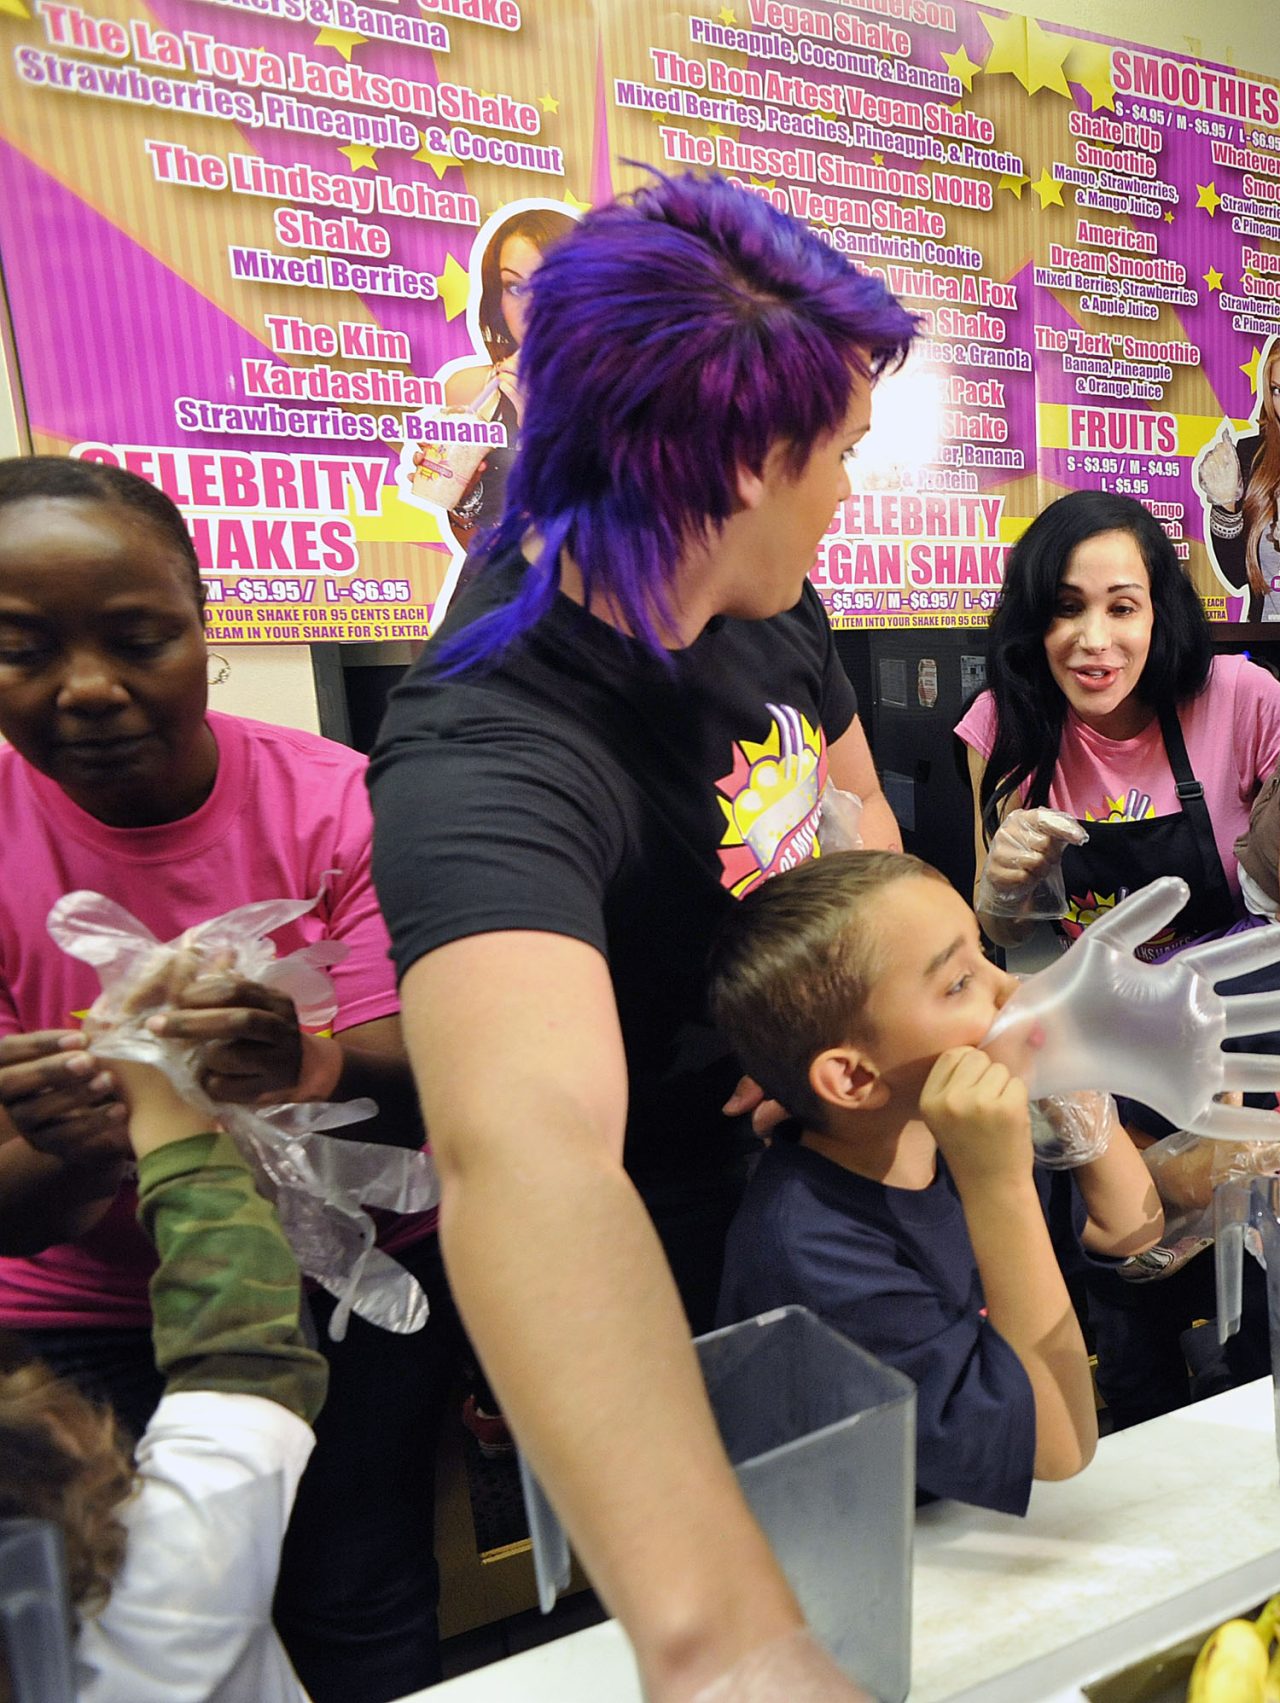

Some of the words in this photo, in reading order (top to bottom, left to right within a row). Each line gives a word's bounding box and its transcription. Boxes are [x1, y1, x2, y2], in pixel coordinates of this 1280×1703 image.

[336, 0, 447, 49] Banana
[750, 0, 833, 40] Vegan
[834, 12, 910, 56] Shake
[42, 4, 127, 54] The
[139, 22, 181, 66] La
[186, 35, 283, 86] Toya
[287, 54, 433, 113] Jackson
[440, 86, 539, 133] Shake
[690, 19, 798, 63] Pineapple,
[800, 41, 878, 75] Coconut
[880, 62, 893, 80] &
[895, 62, 962, 95] Banana
[653, 51, 703, 86] The
[710, 63, 761, 98] Ron
[766, 73, 843, 113] Artest
[845, 89, 923, 130] Vegan
[926, 106, 994, 143] Shake
[1111, 50, 1280, 125] SMOOTHIES
[19, 49, 261, 127] Strawberries,
[266, 96, 418, 147] Pineapple
[427, 129, 447, 152] &
[451, 131, 562, 172] Coconut
[617, 82, 680, 113] Mixed
[685, 93, 765, 128] Berries,
[767, 111, 854, 145] Peaches,
[855, 125, 946, 160] Pineapple,
[948, 144, 962, 162] &
[963, 144, 1023, 175] Protein
[1070, 113, 1122, 140] Shake
[1124, 123, 1139, 146] it
[1139, 126, 1162, 153] Up
[661, 128, 713, 162] The
[718, 138, 815, 178] Russell
[818, 155, 929, 198] Simmons
[934, 175, 993, 210] NOH8
[1076, 143, 1156, 177] Smoothie
[149, 142, 225, 186] The
[232, 156, 374, 211] Lindsay
[378, 177, 478, 223] Lohan
[1053, 164, 1100, 188] Mango,
[1099, 174, 1178, 202] Strawberries,
[1076, 191, 1085, 204] &
[1086, 192, 1127, 214] Mango
[1129, 198, 1161, 217] Juice
[278, 210, 389, 255] Shake
[788, 187, 870, 225] Vegan
[873, 200, 944, 237] Shake
[835, 229, 922, 260] Sandwich
[924, 243, 982, 269] Cookie
[1077, 221, 1157, 253] American
[233, 249, 325, 288] Mixed
[331, 264, 435, 298] Berries
[1050, 246, 1108, 272] Dream
[1109, 256, 1186, 283] Smoothie
[889, 266, 960, 300] Vivica
[963, 279, 978, 303] A
[980, 282, 1016, 309] Fox
[1035, 269, 1073, 288] Mixed
[1074, 276, 1123, 297] Berries,
[1124, 282, 1198, 305] Strawberries
[268, 317, 335, 355] The
[342, 325, 408, 361] Kim
[938, 308, 1004, 340] Shake
[1035, 327, 1067, 349] The
[1124, 341, 1200, 364] Smoothie
[955, 346, 967, 362] &
[970, 345, 1030, 369] Granola
[245, 361, 443, 406] Kardashian
[951, 377, 1004, 406] Pack
[179, 400, 375, 439] Strawberries
[382, 416, 402, 439] &
[406, 415, 505, 444] Banana
[1071, 408, 1177, 453] FRUITS
[963, 446, 1023, 467] Banana
[78, 449, 385, 513] ELEBRITY
[825, 494, 1000, 537] CELEBRITY
[184, 518, 356, 571] HAKES
[811, 543, 901, 585] EGAN
[910, 545, 1009, 586] SHAK
[205, 626, 244, 640] REAM
[247, 626, 261, 639] IN
[263, 626, 300, 639] YOUR
[302, 626, 345, 639] SHAKE
[347, 625, 372, 638] FOR
[374, 624, 389, 638] $1
[392, 625, 430, 638] EXTRA
[215, 608, 254, 622] YOUR
[257, 608, 301, 622] SHAKE
[302, 608, 327, 622] FOR
[330, 609, 348, 622] 95
[351, 608, 391, 622] CENTS
[393, 608, 425, 621] EACH
[842, 616, 863, 628] ITEM
[865, 616, 885, 628] INTO
[887, 615, 911, 628] YOUR
[911, 615, 939, 627] SHAKE
[940, 615, 957, 627] FOR
[957, 615, 970, 626] 95
